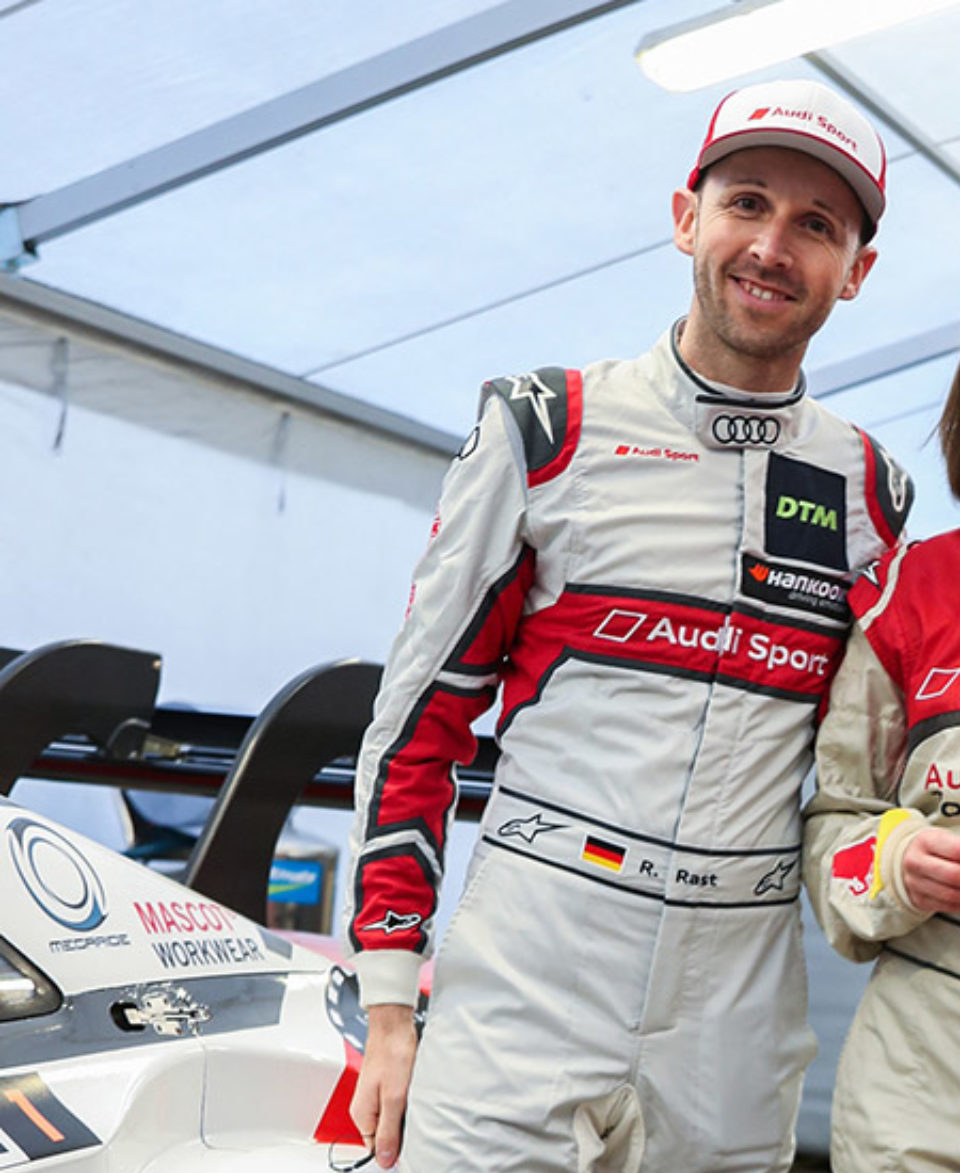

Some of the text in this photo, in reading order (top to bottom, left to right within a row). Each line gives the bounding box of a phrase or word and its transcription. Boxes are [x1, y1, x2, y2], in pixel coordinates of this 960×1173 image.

[664, 448, 698, 462] Sport
[776, 495, 838, 530] DTM
[646, 615, 829, 676] Audi Sport
[639, 859, 718, 887] R. Rast
[151, 938, 264, 969] WORKWEAR
